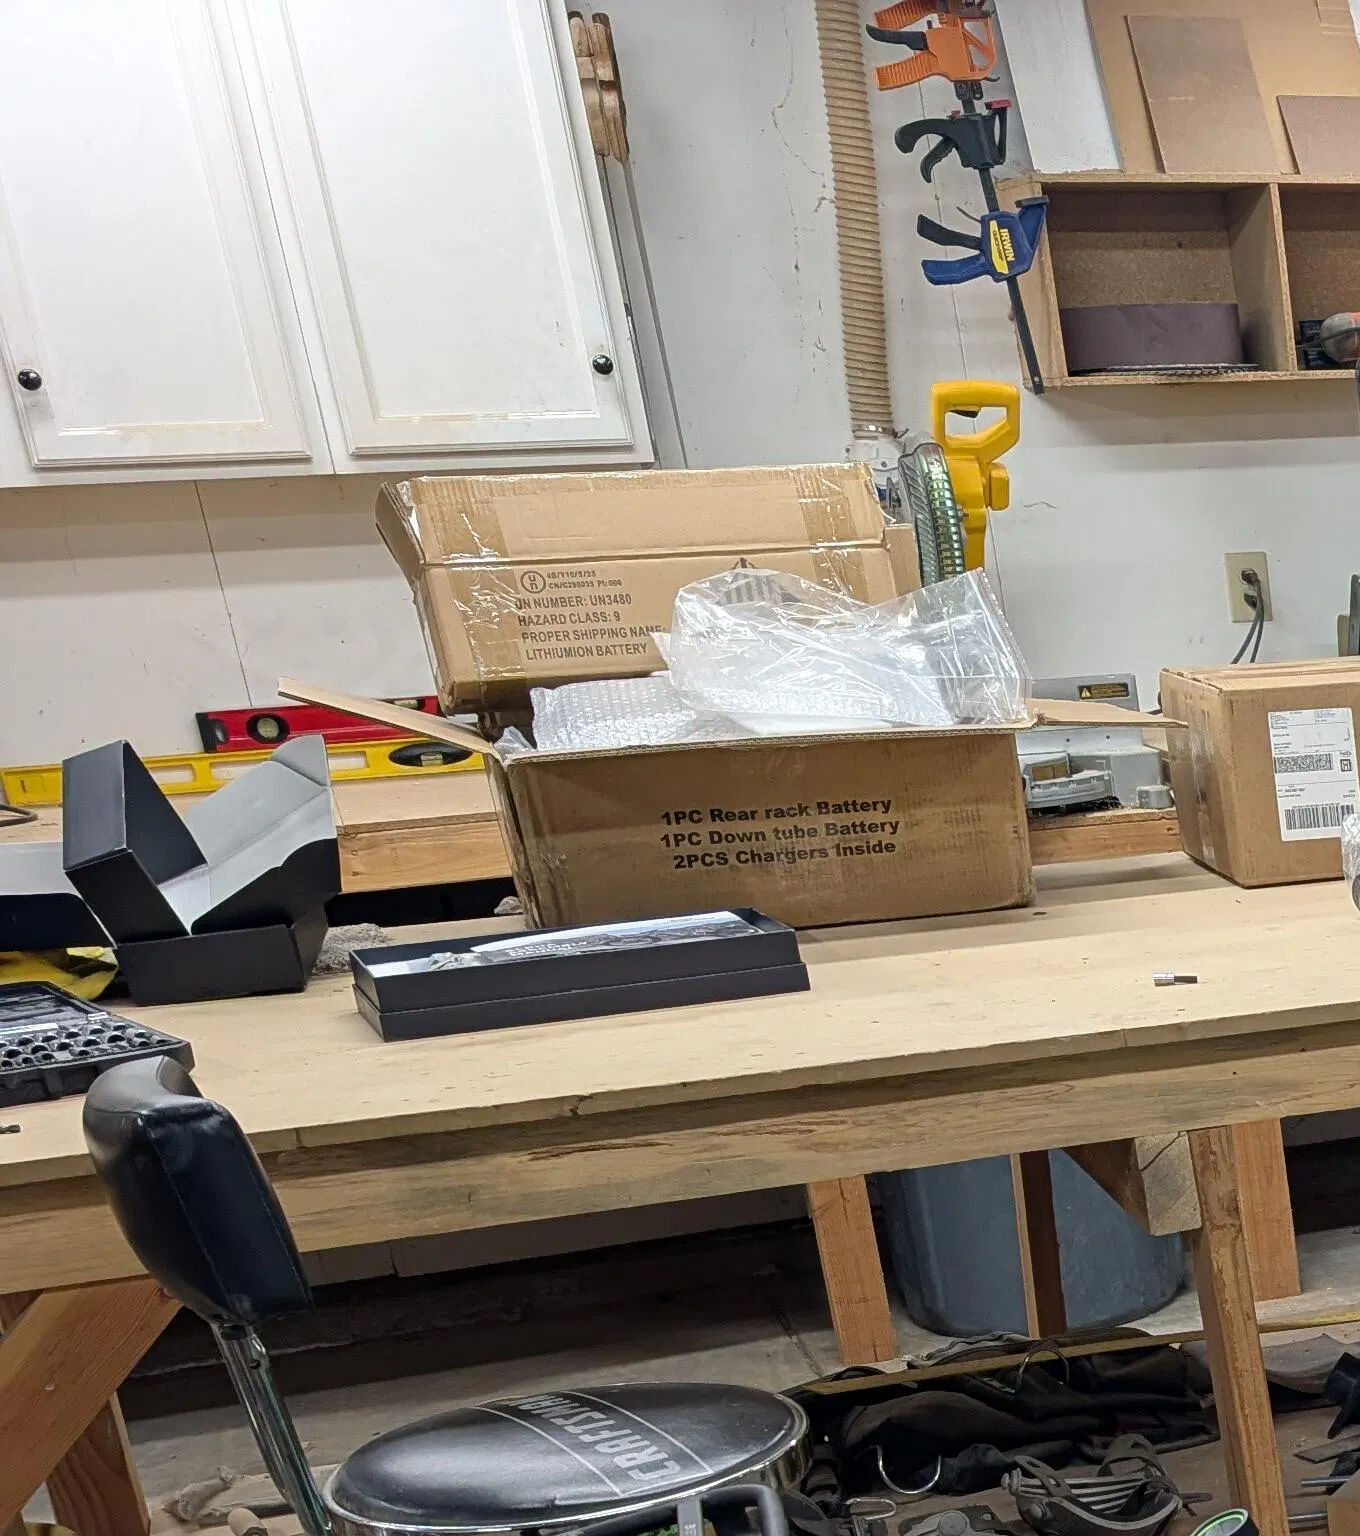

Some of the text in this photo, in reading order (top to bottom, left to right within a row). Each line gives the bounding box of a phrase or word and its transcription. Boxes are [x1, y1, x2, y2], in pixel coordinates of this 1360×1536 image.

[1000, 228, 1016, 262] IRWIN
[515, 593, 632, 610] UN NUMBER: UN3480
[517, 610, 621, 627] HAZARD CLASS: 9
[521, 631, 570, 645] PROPER
[573, 627, 628, 641] SHIPPING
[525, 643, 648, 661] LITHIUMION BATTERY
[660, 799, 892, 826] 1PC Rear rack Battery
[660, 819, 900, 848] 1PC Down tube Battery
[673, 840, 896, 870] 2PCS Chargers Inside
